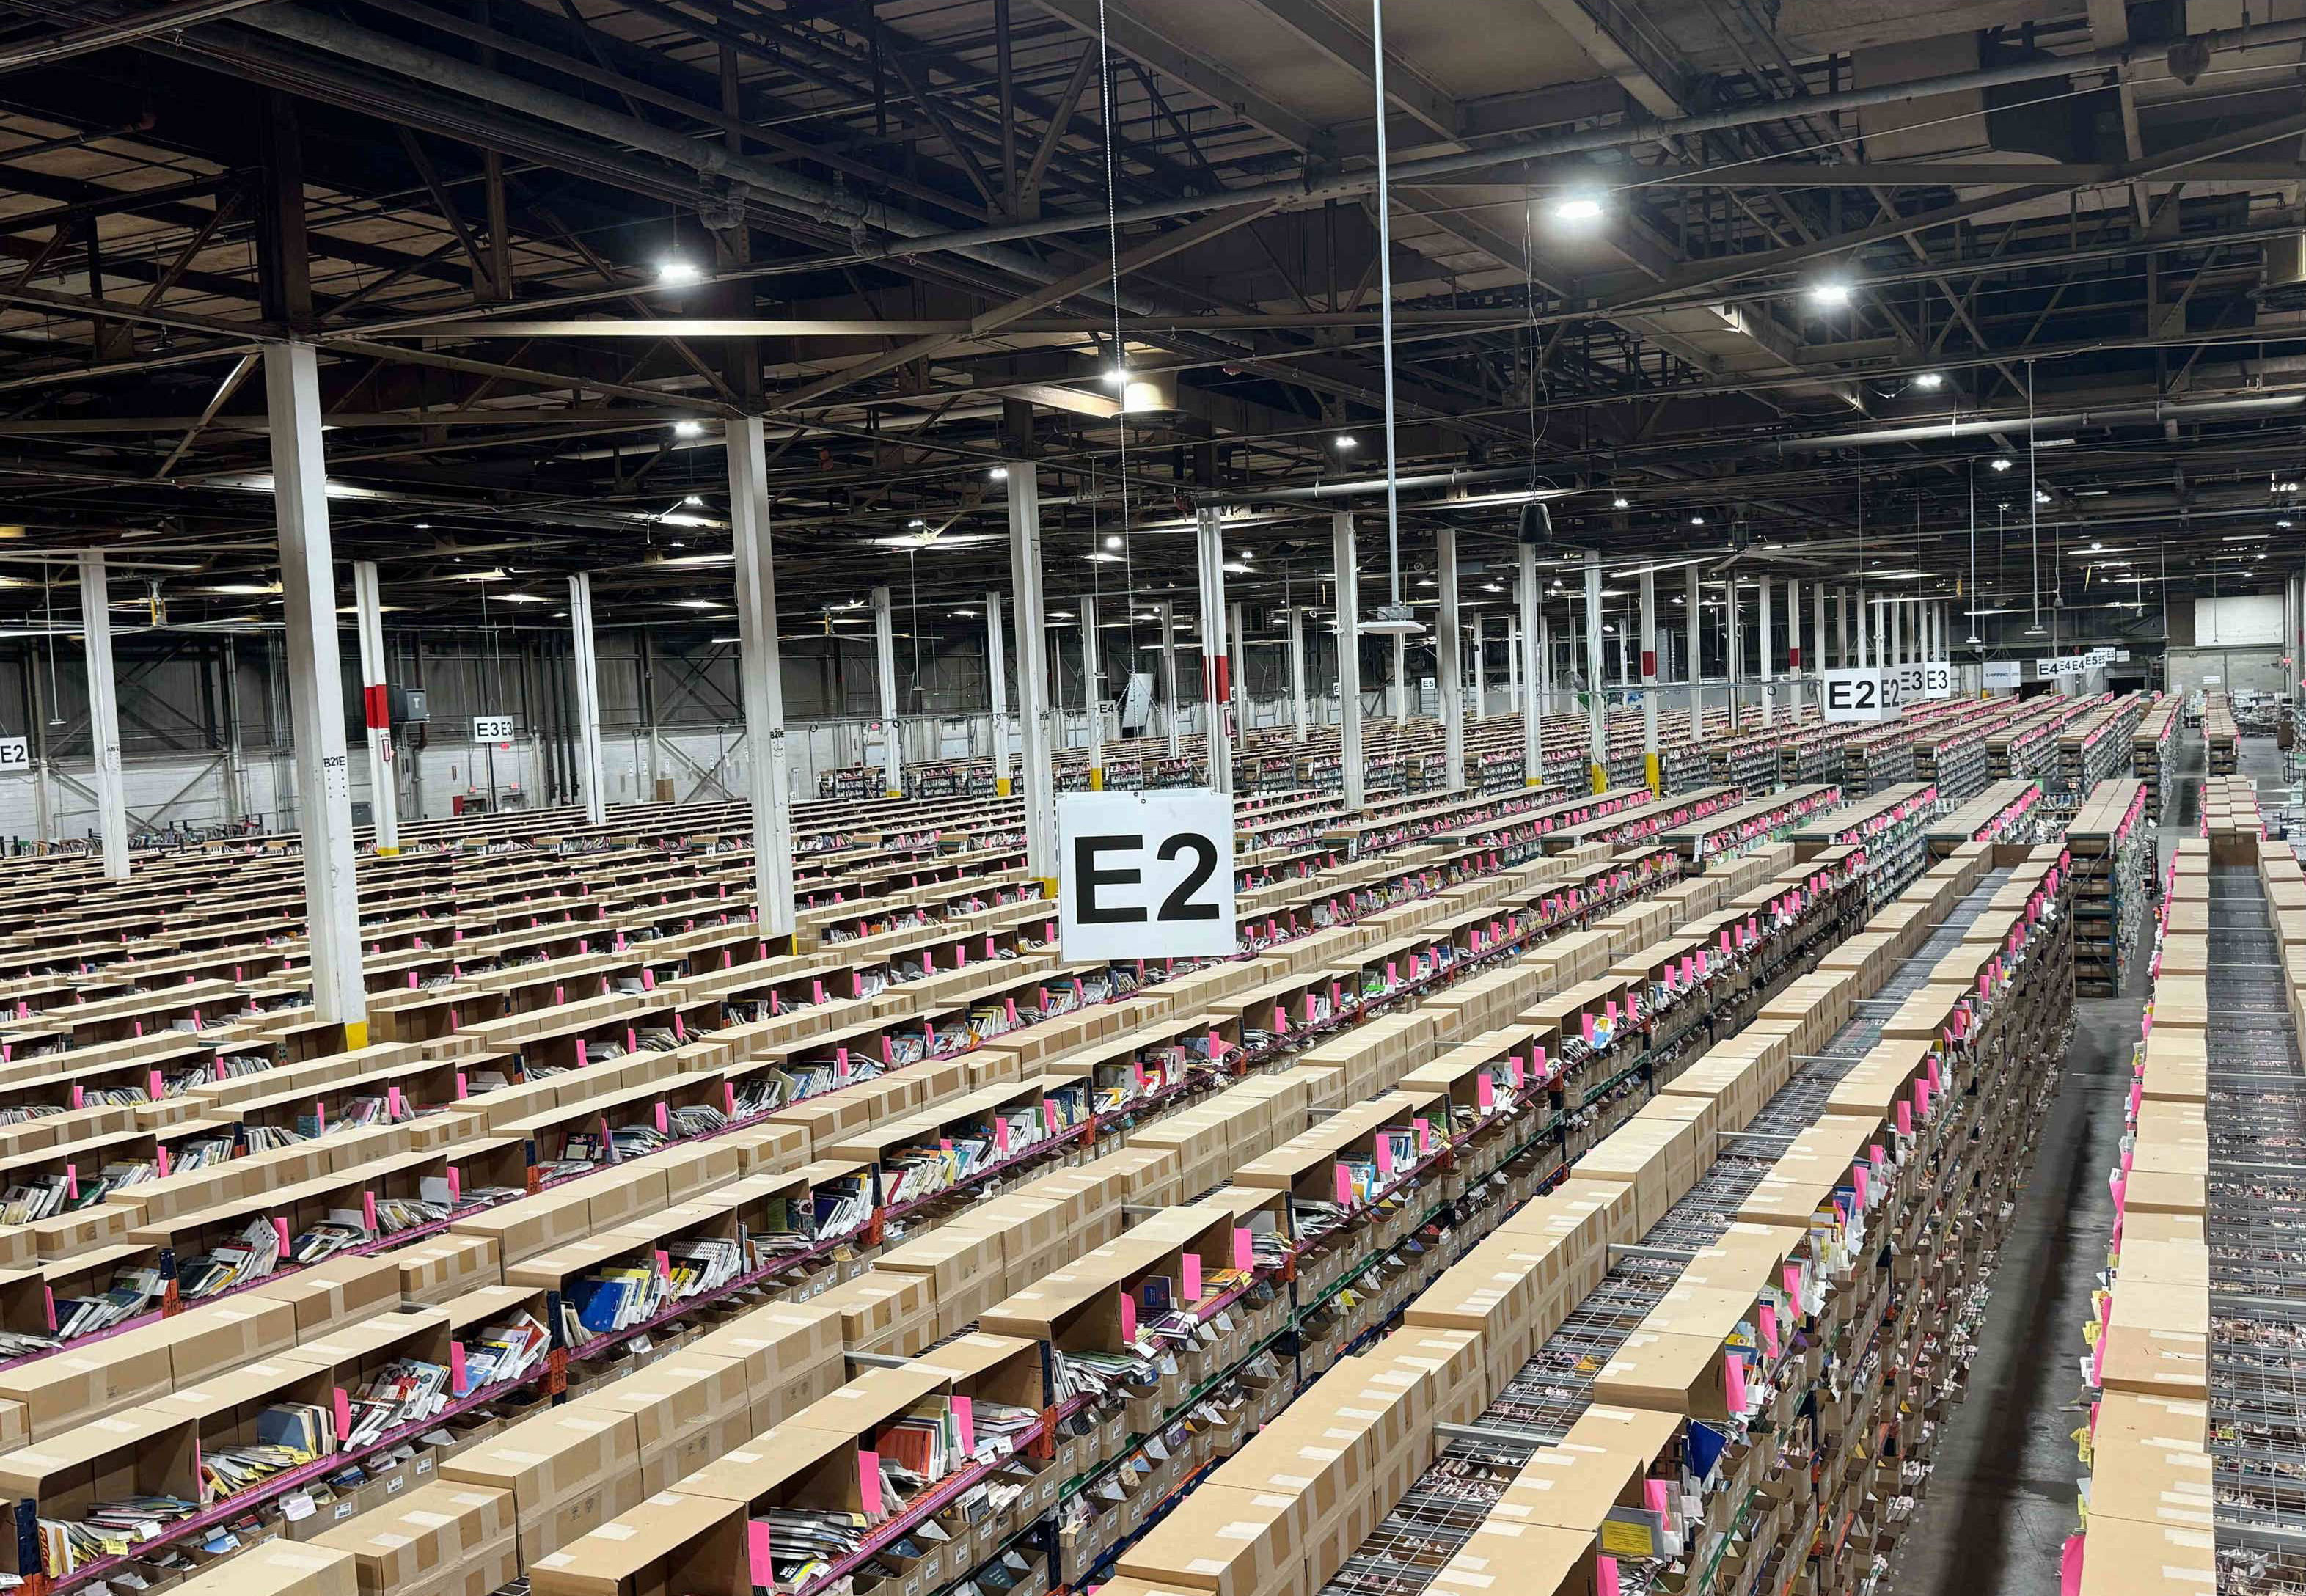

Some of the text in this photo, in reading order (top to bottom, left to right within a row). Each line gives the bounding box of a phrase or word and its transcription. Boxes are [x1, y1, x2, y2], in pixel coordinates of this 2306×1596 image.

[2072, 660, 2084, 670] E4
[2085, 656, 2098, 665] E5
[2039, 663, 2059, 675] E4
[1927, 670, 1948, 689] E3
[1829, 680, 1875, 709] E2
[1881, 678, 1900, 708] E2
[1099, 704, 1114, 714] E4
[477, 722, 499, 736] E3
[502, 722, 513, 736] E3
[0, 744, 26, 764] E2
[323, 756, 346, 767] B21E
[1075, 832, 1220, 924] E2
